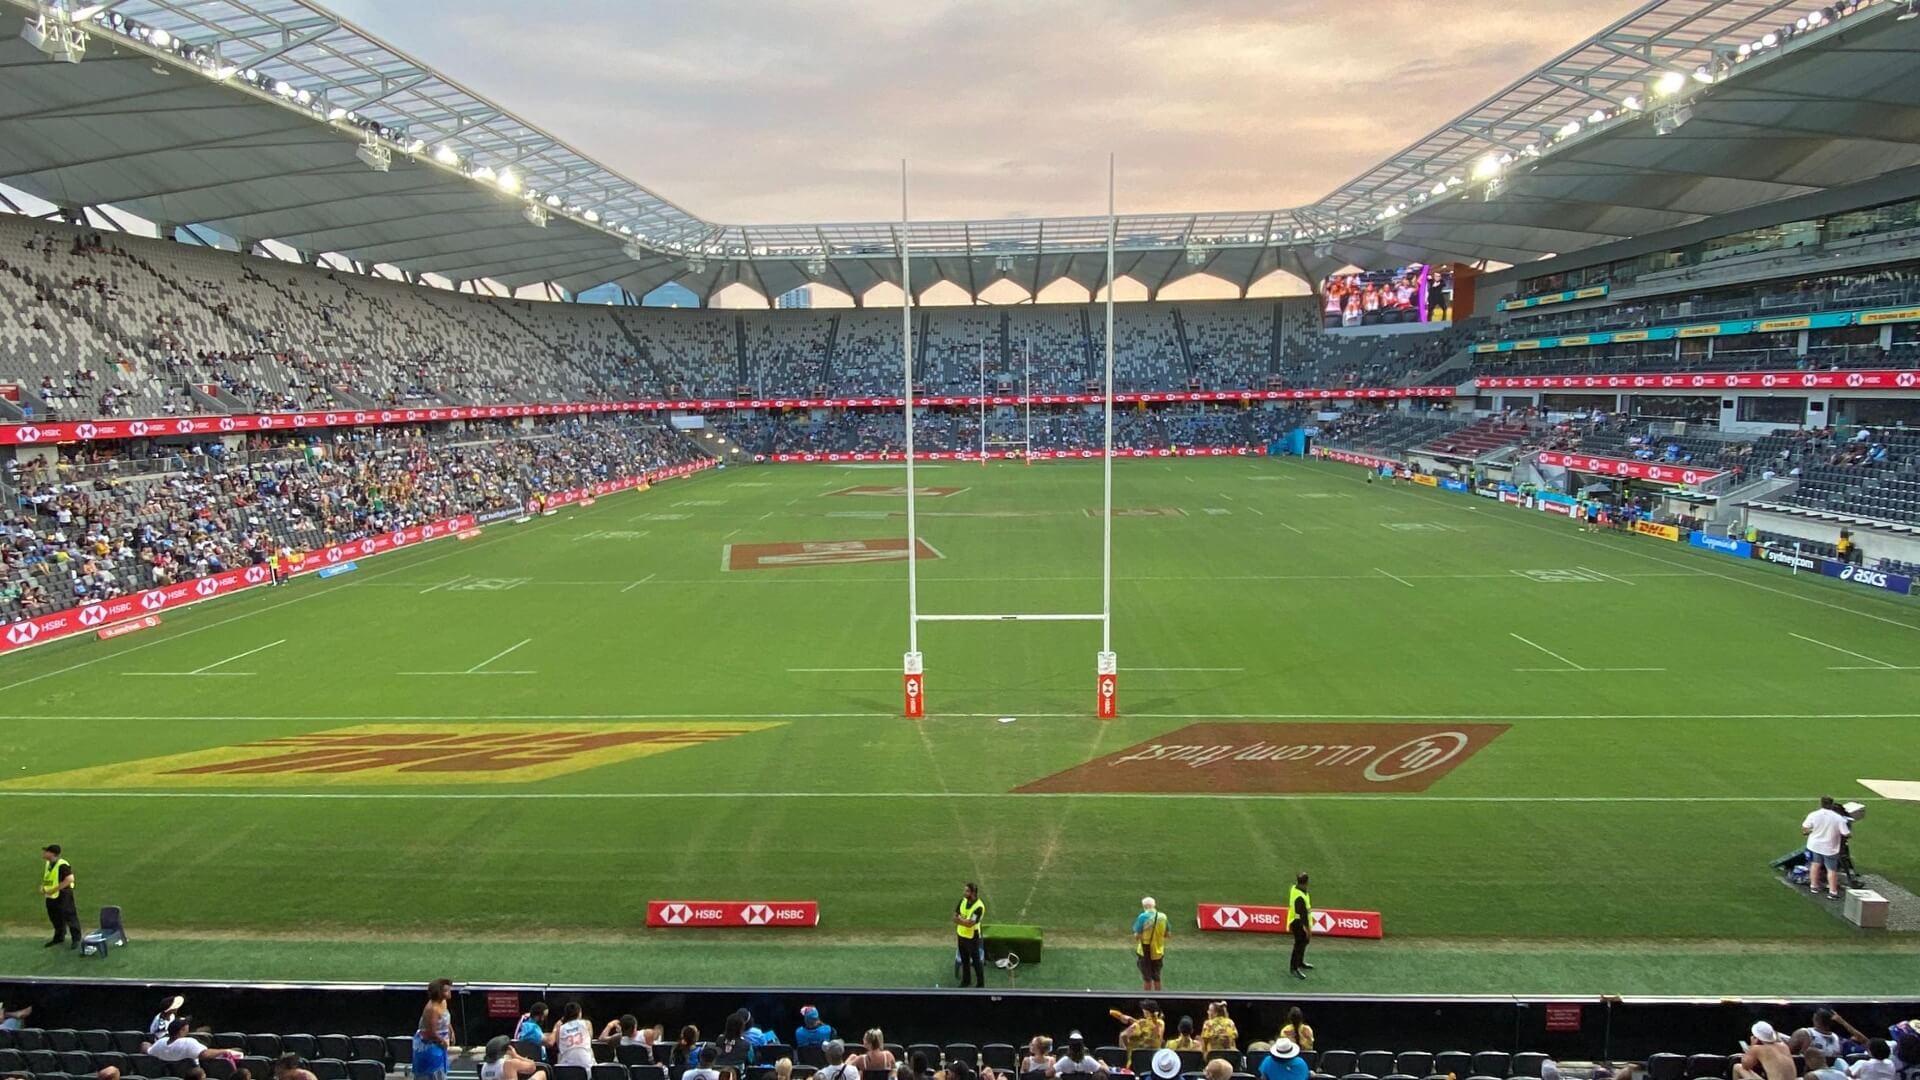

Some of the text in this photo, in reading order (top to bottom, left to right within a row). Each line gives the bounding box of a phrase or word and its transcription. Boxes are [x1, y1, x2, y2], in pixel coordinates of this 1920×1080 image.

[42, 429, 61, 437] HSBC
[1640, 522, 1666, 536] DHL
[1768, 552, 1814, 569] sydneycom
[1854, 569, 1888, 587] asics
[42, 618, 68, 633] HSBC
[109, 602, 132, 615] HSBC
[168, 589, 188, 600] HSBC
[695, 910, 804, 920] HSBC HSBC
[1250, 914, 1369, 929] HSBC HSBC
